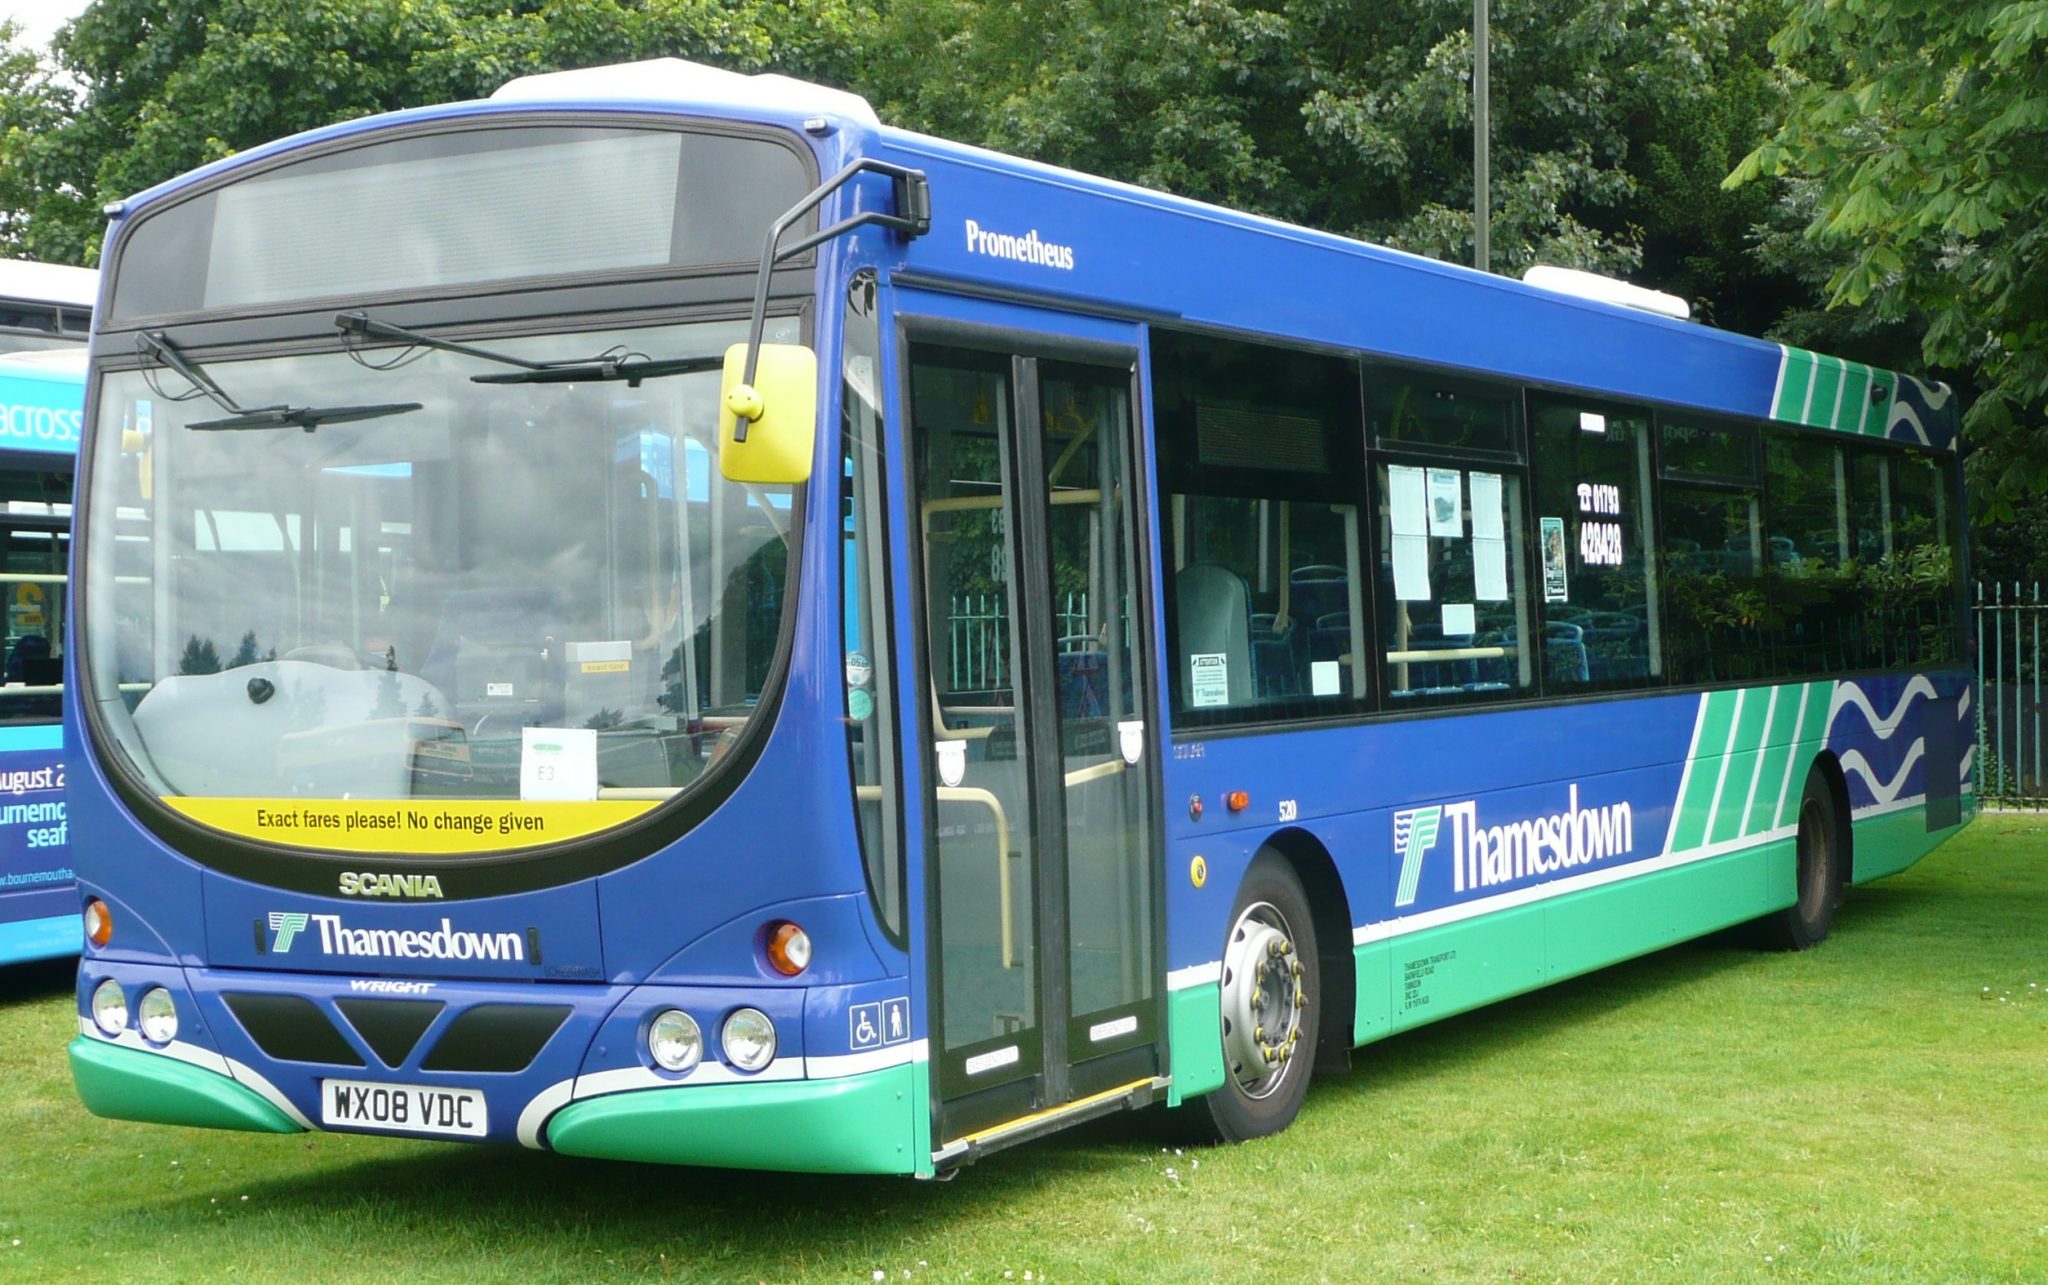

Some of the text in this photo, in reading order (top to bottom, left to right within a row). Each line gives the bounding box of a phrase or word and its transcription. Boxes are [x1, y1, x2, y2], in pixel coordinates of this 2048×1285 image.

[965, 219, 1074, 270] Prometheus
[1593, 484, 1620, 515] 01793
[1580, 522, 1622, 565] 428428
[0, 766, 53, 795] ugust
[537, 765, 555, 782] E3
[257, 809, 545, 834] Exact fares please! No change given
[1278, 799, 1297, 823] 520
[1444, 784, 1633, 893] Thamesdown
[339, 871, 444, 898] SCANIA
[312, 914, 524, 960] Thamesdown
[350, 980, 437, 995] WRIGHT
[333, 1085, 474, 1129] WX08 VDC
